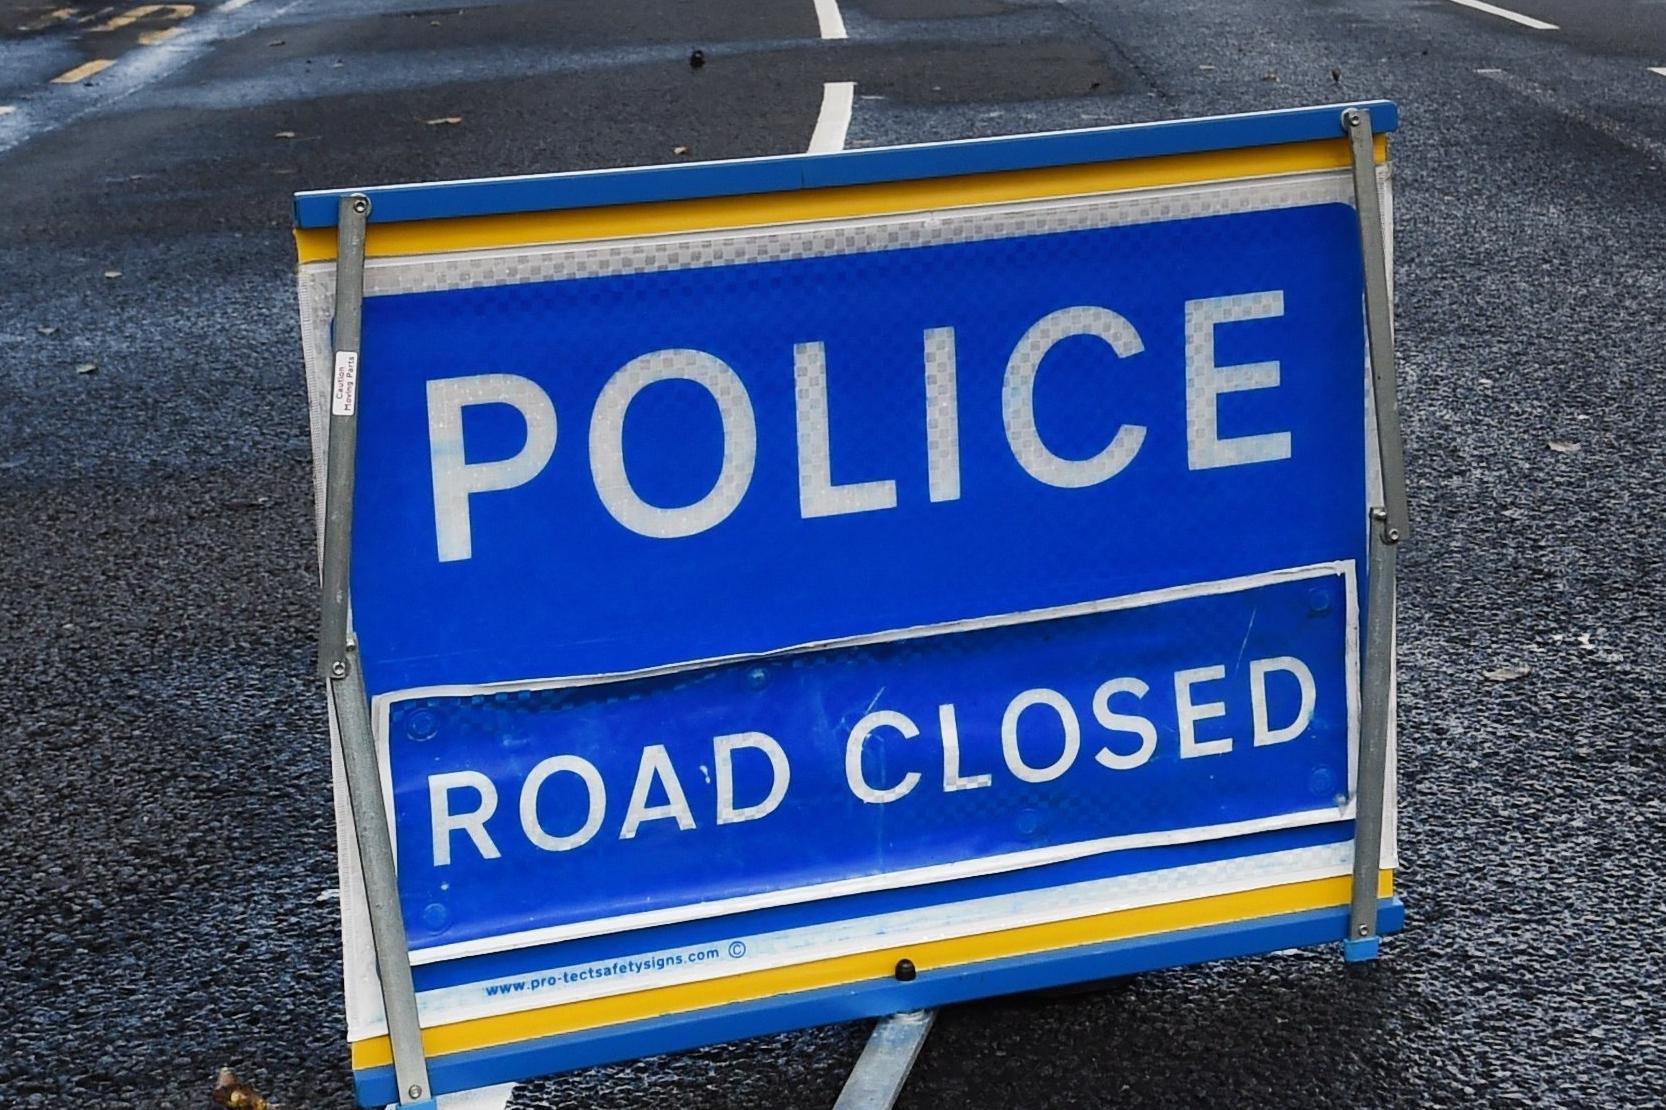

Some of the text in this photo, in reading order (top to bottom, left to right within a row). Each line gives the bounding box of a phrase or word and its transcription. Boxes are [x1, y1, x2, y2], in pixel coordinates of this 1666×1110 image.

[336, 366, 345, 400] Caution
[344, 356, 355, 411] Moving Parts
[426, 290, 1292, 562] POLICE
[428, 656, 1318, 867] ROAD CLOSED
[485, 947, 720, 997] www.pro-tectsafetysigns.com
